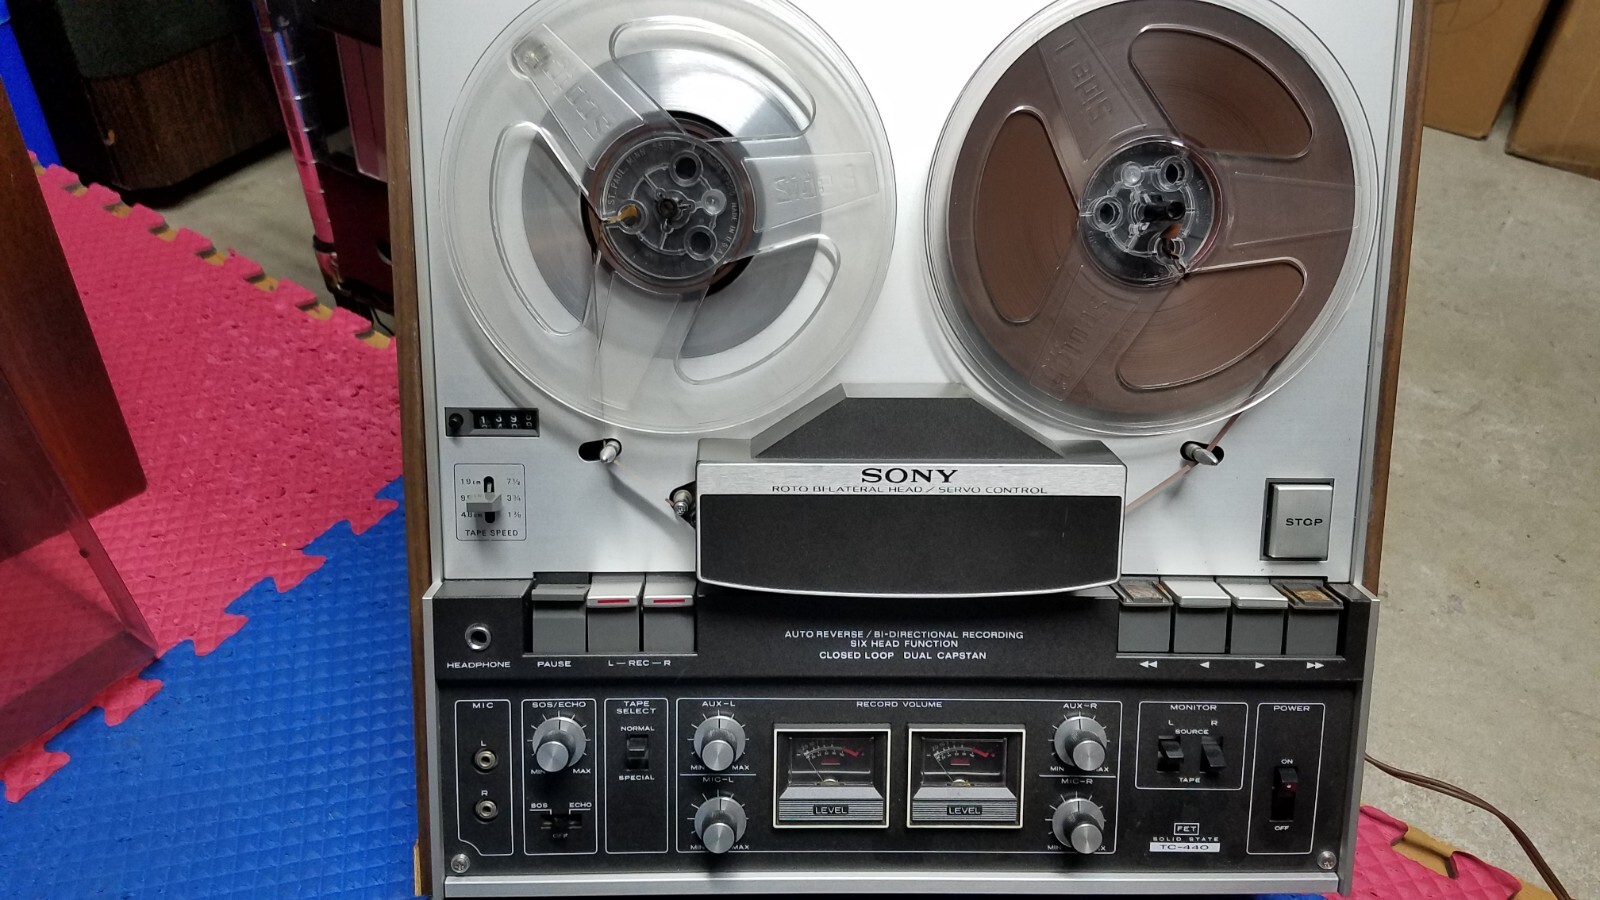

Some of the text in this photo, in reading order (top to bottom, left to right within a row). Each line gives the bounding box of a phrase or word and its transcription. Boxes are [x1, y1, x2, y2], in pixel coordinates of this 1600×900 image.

[861, 467, 958, 483] SONY
[772, 485, 809, 493] ROTO
[812, 485, 884, 493] BI-LATERAL
[888, 486, 923, 494] HEAD
[938, 486, 981, 494] SERVO
[985, 486, 1047, 494] CONTROL
[1285, 518, 1323, 526] STOP
[784, 630, 815, 638] AUTO
[816, 630, 864, 638] REVERSE
[873, 631, 959, 639] BI-DIRECTIONAL
[962, 631, 1024, 639] RECORDING
[904, 640, 958, 648] FUNCTION
[819, 651, 862, 659] CLOSED
[864, 651, 894, 659] LOOP
[936, 652, 987, 660] CAPSTAN
[446, 661, 511, 669] HEADPHONE
[537, 660, 572, 668] PAUSE
[815, 806, 848, 815] LEVEL
[948, 806, 981, 815] LEVEL
